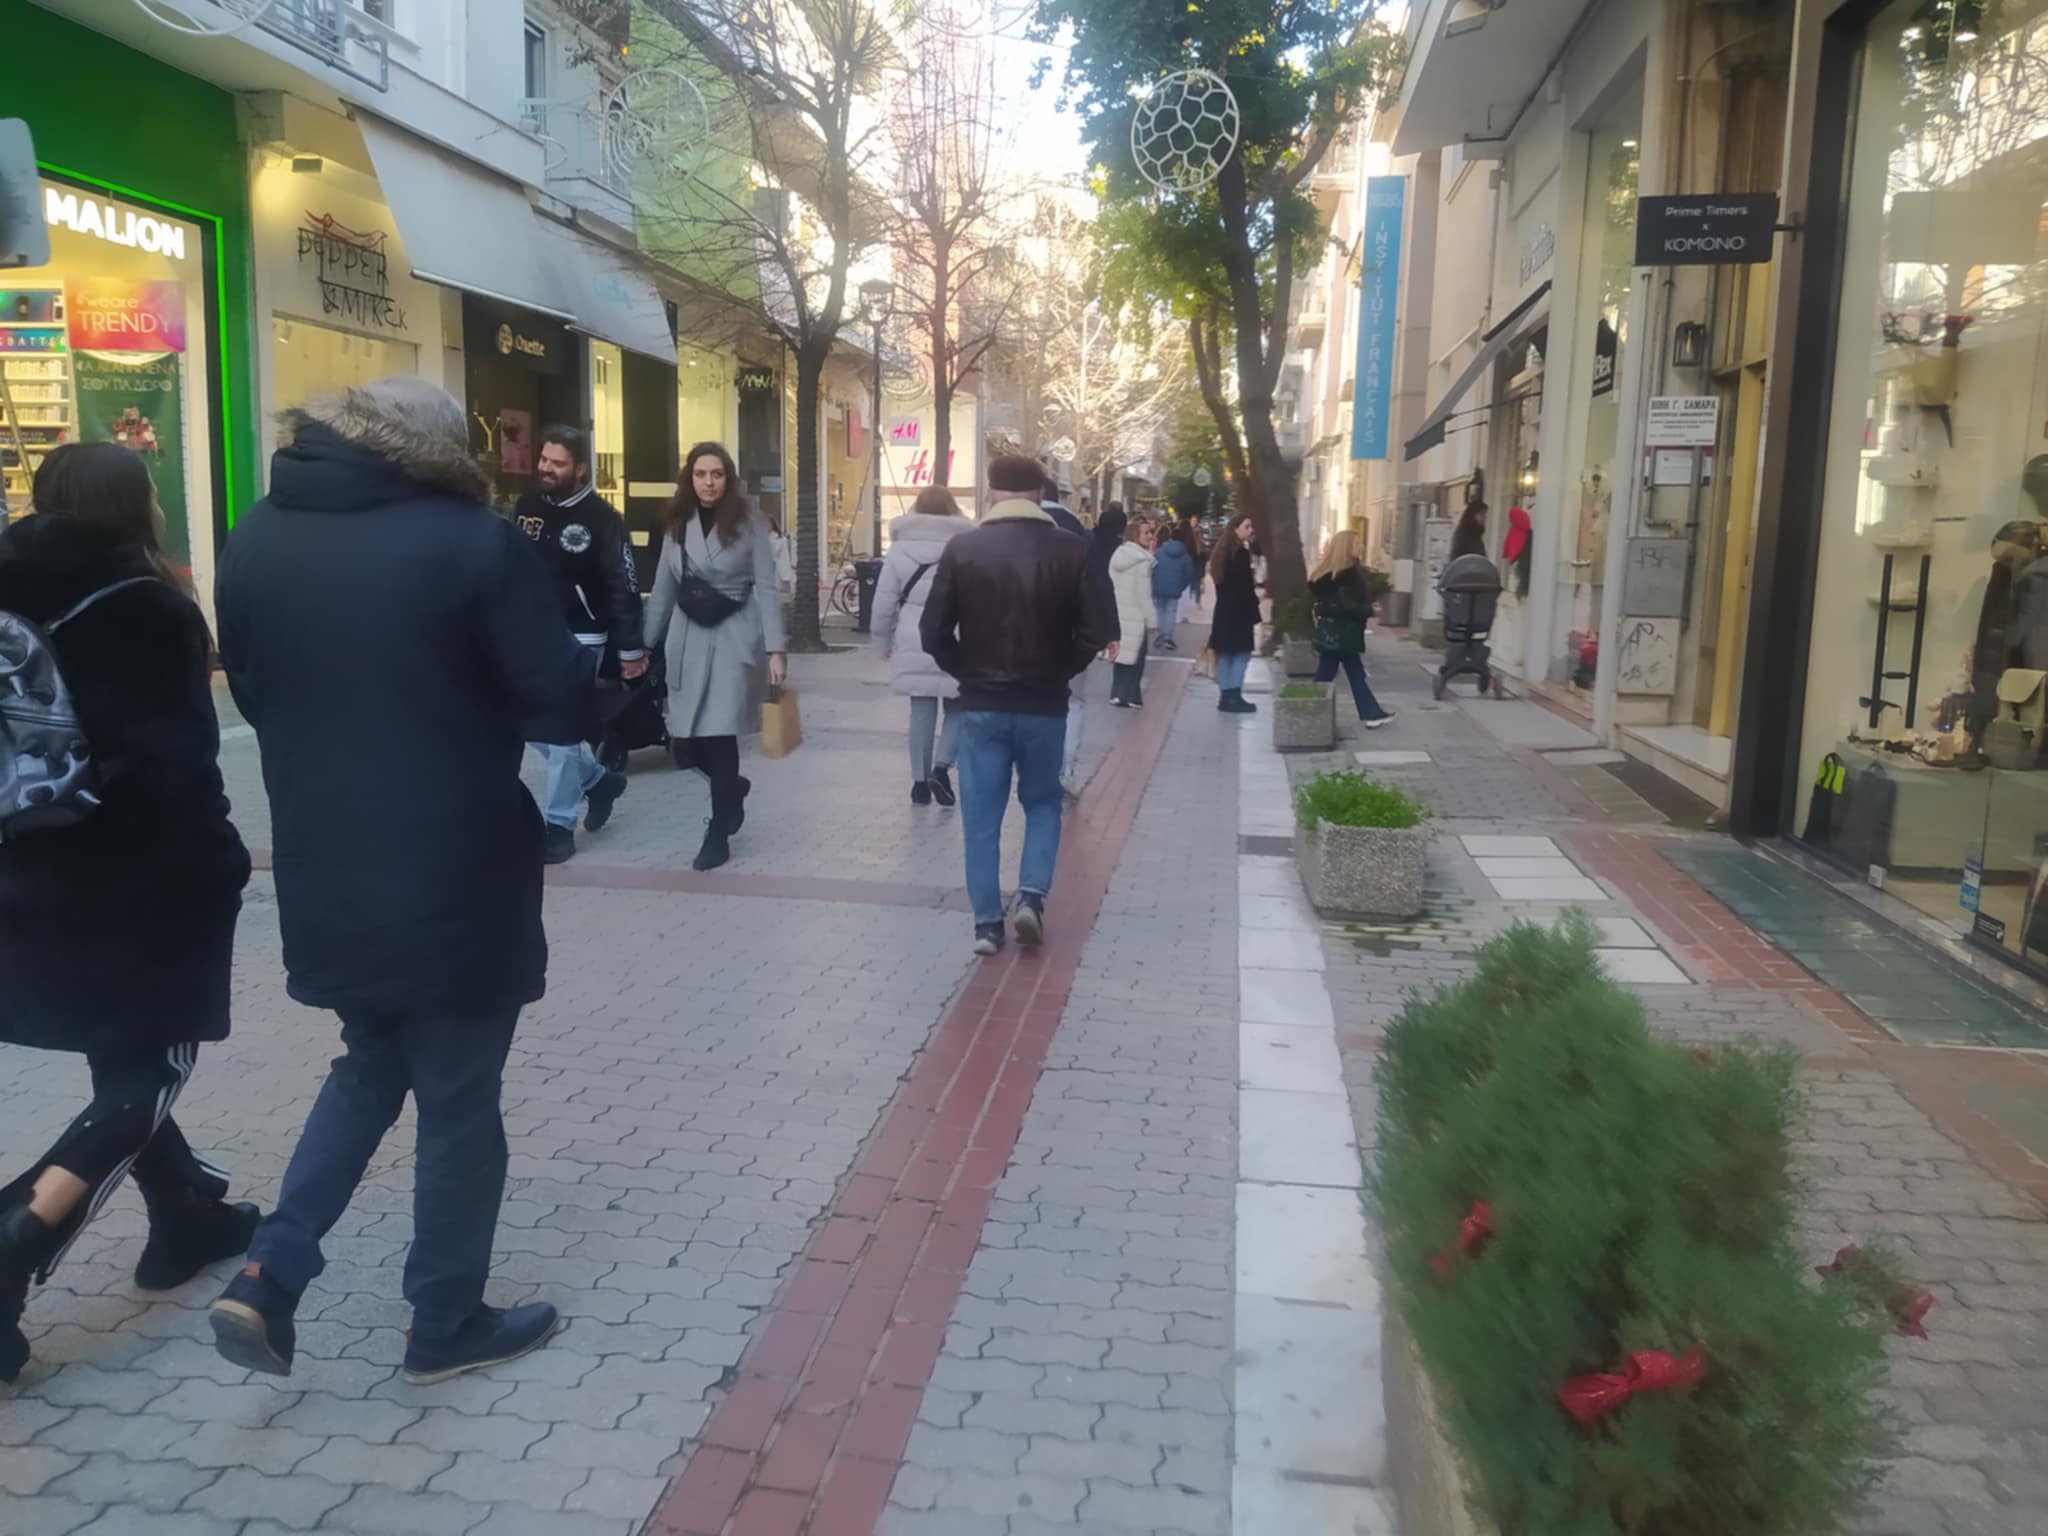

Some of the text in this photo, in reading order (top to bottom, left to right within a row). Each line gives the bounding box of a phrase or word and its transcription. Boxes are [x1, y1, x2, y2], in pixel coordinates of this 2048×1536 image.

[1664, 205, 1749, 217] Prime Timers
[1663, 236, 1745, 252] KOMONO
[78, 310, 170, 334] TRENDY
